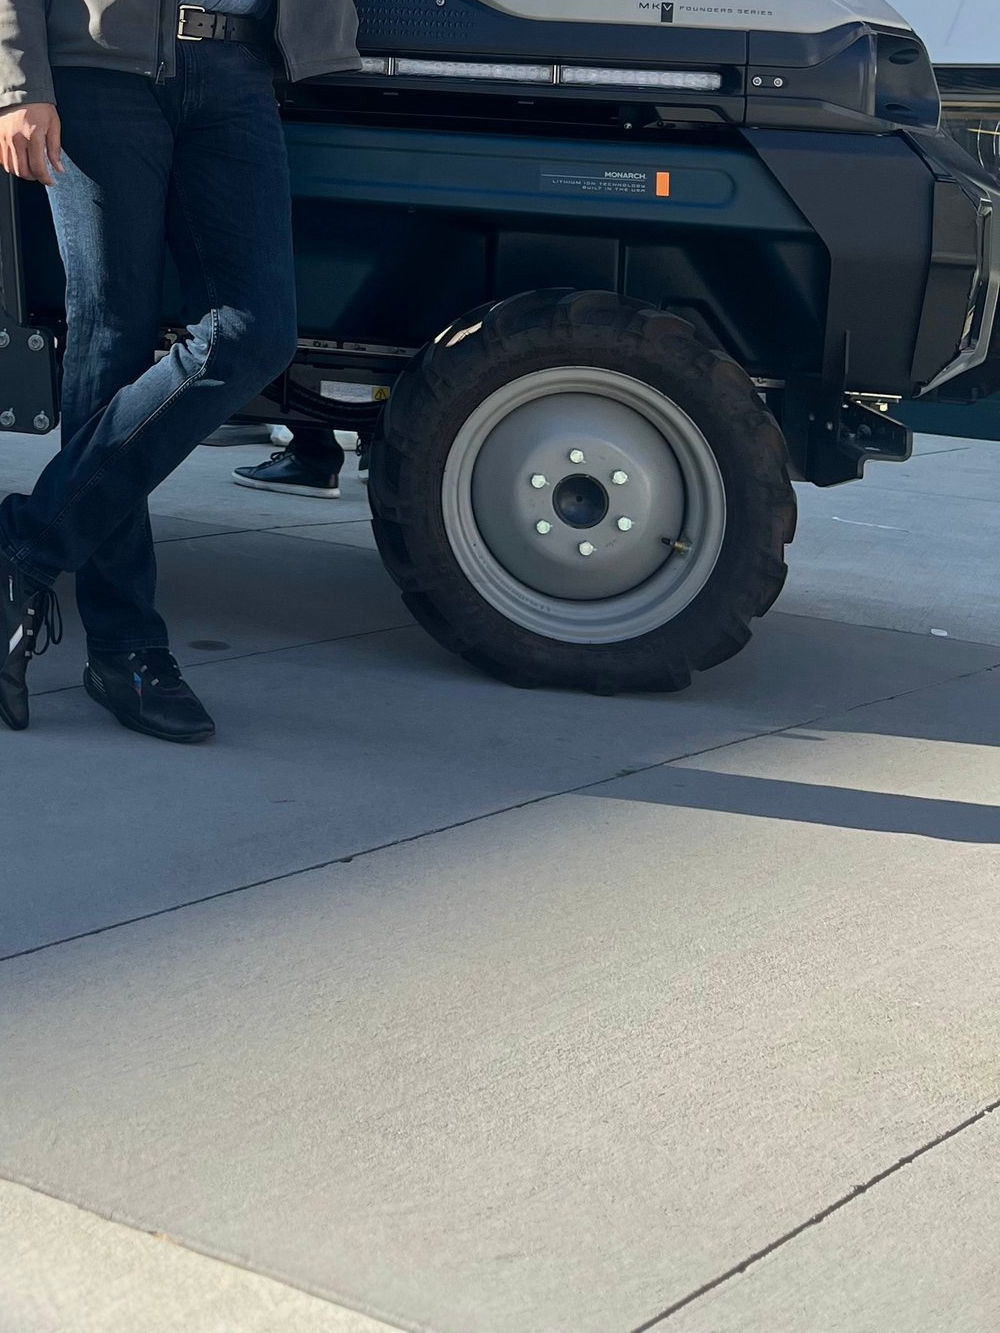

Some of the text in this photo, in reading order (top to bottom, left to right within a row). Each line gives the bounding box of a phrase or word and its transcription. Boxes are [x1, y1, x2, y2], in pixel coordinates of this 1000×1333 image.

[679, 5, 733, 14] FOUNDERS
[737, 8, 774, 16] SERIES
[604, 171, 646, 180] MONARCH
